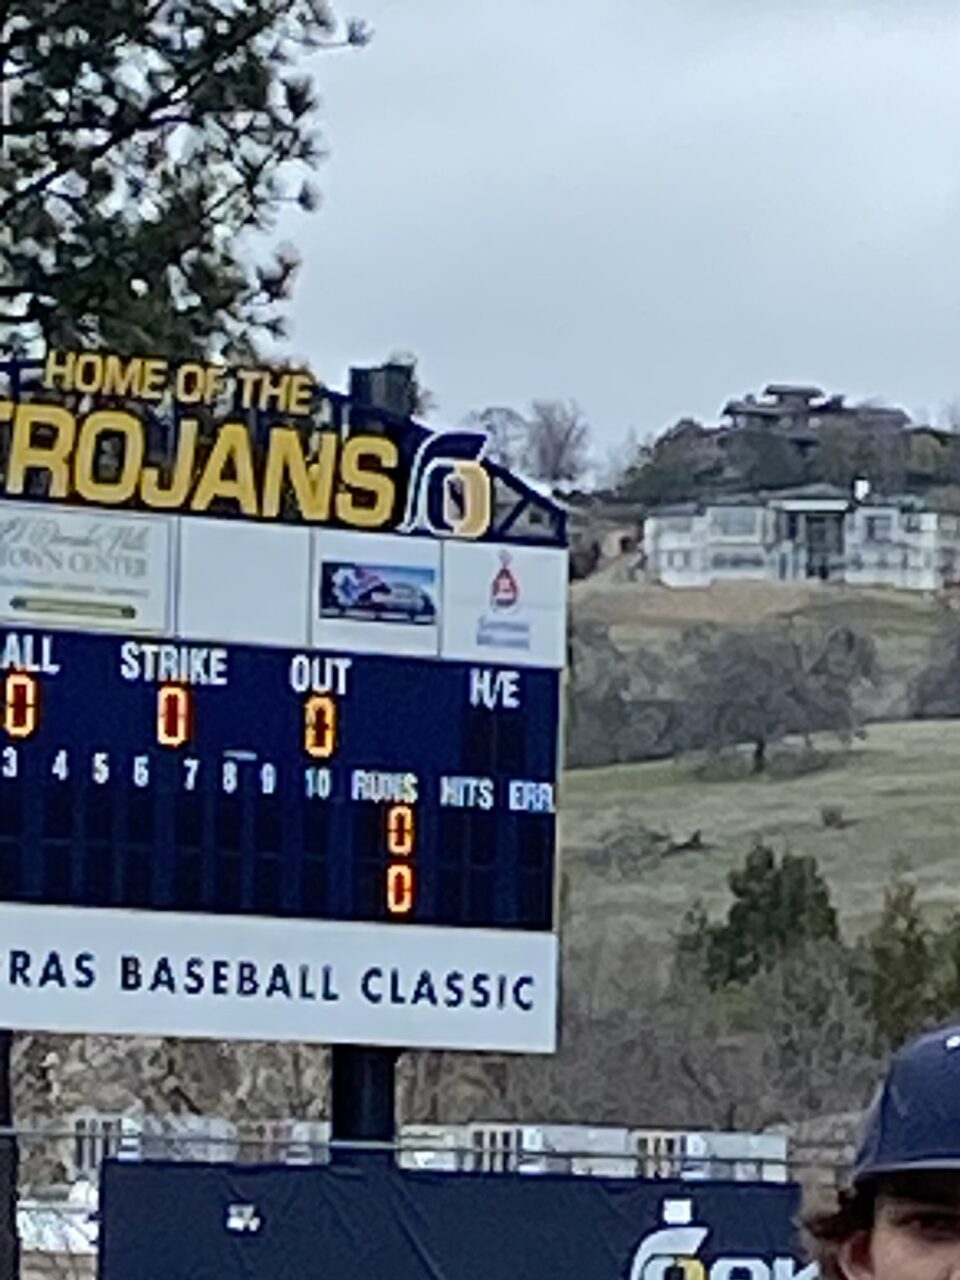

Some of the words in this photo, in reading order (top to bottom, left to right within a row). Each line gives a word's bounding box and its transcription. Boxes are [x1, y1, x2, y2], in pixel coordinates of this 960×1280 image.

[44, 350, 168, 400] HOME
[177, 364, 226, 404] OF
[237, 368, 313, 415] THE
[0, 400, 398, 527] ROJANS
[120, 641, 228, 685] STRIKE
[289, 654, 352, 695] OUT
[469, 668, 521, 710] H/E
[6, 673, 35, 738] 0
[157, 686, 187, 745] 0
[304, 695, 336, 758] 0
[2, 746, 18, 778] 3
[52, 749, 68, 781] 4
[92, 752, 109, 784] 5
[183, 757, 199, 790] 7
[222, 761, 238, 793] 8
[304, 767, 331, 799] 10
[439, 776, 494, 810] HITS
[388, 805, 413, 857] 0
[387, 864, 412, 913] 0
[8, 950, 96, 988] RAS
[120, 955, 340, 1001] BASEBALL
[360, 966, 535, 1011] CLASSIC
